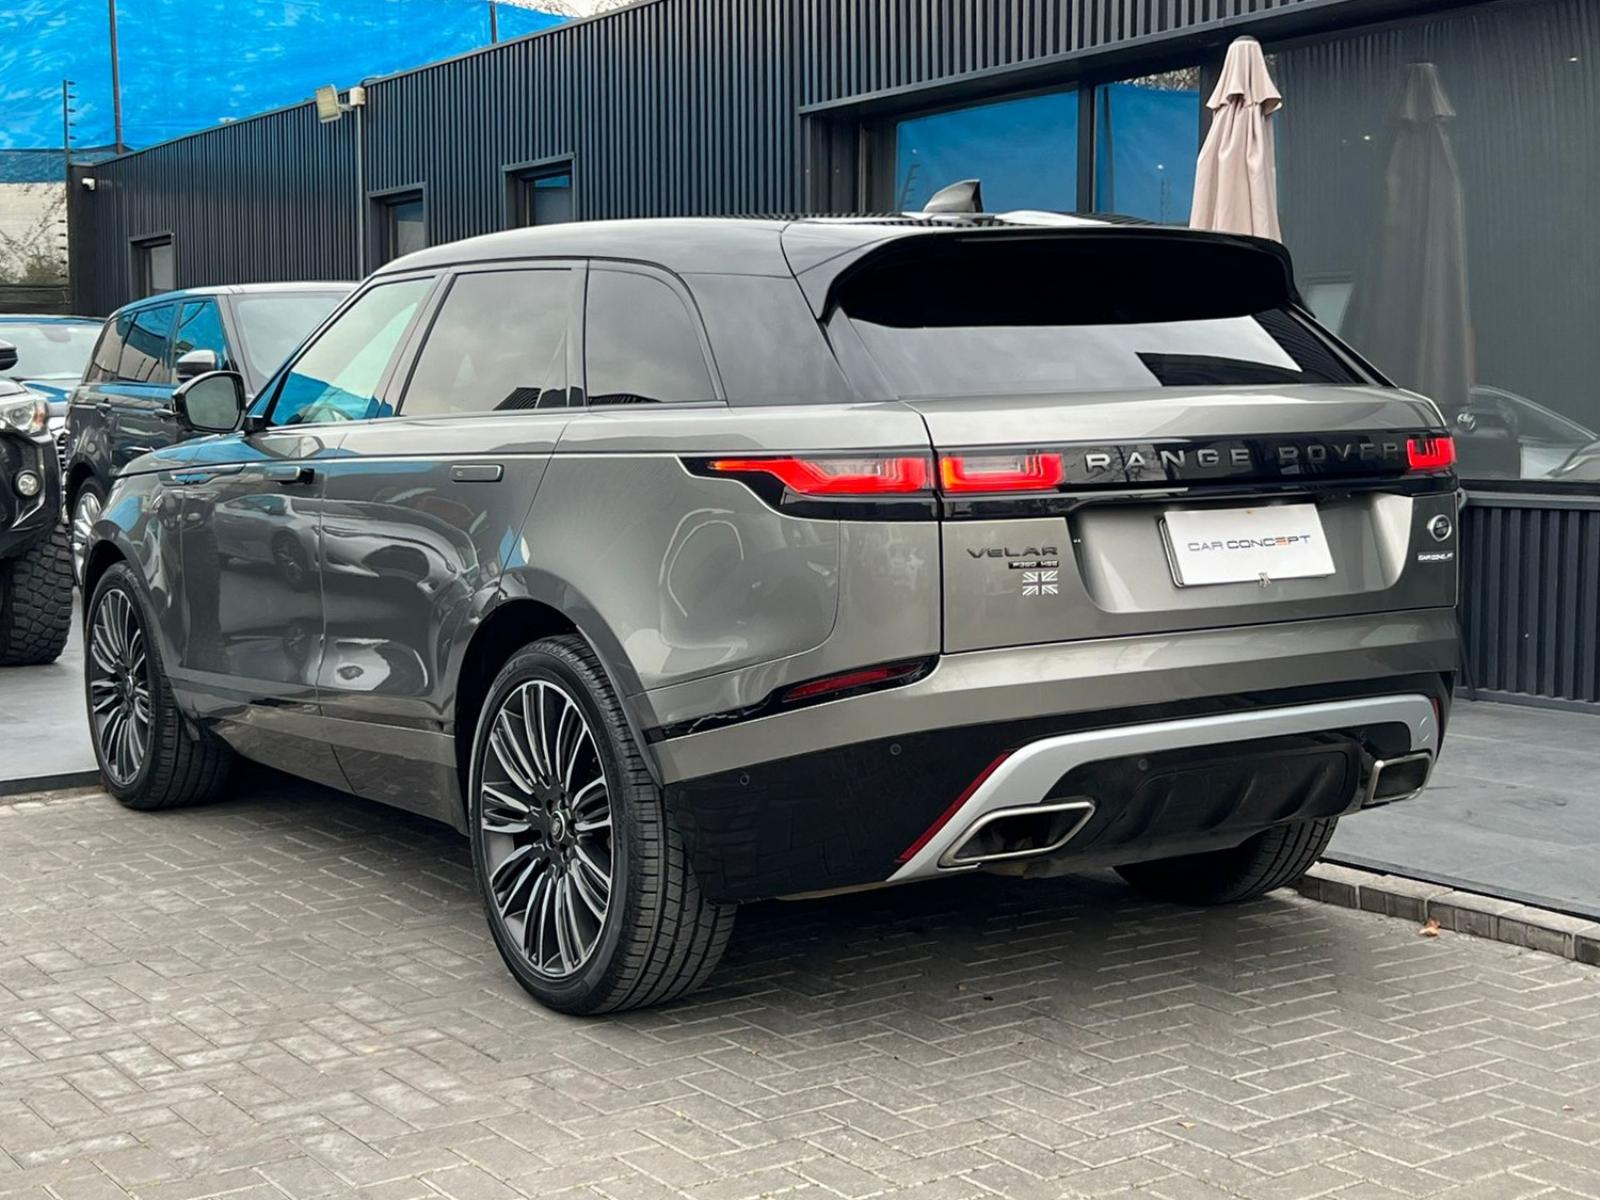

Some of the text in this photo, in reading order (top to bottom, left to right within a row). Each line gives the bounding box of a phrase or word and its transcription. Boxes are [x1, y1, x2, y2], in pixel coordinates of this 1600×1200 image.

[1085, 442, 1398, 473] RANGE ROVER
[1187, 534, 1311, 552] CAR CONCEPT
[966, 546, 1058, 559] VELAR
